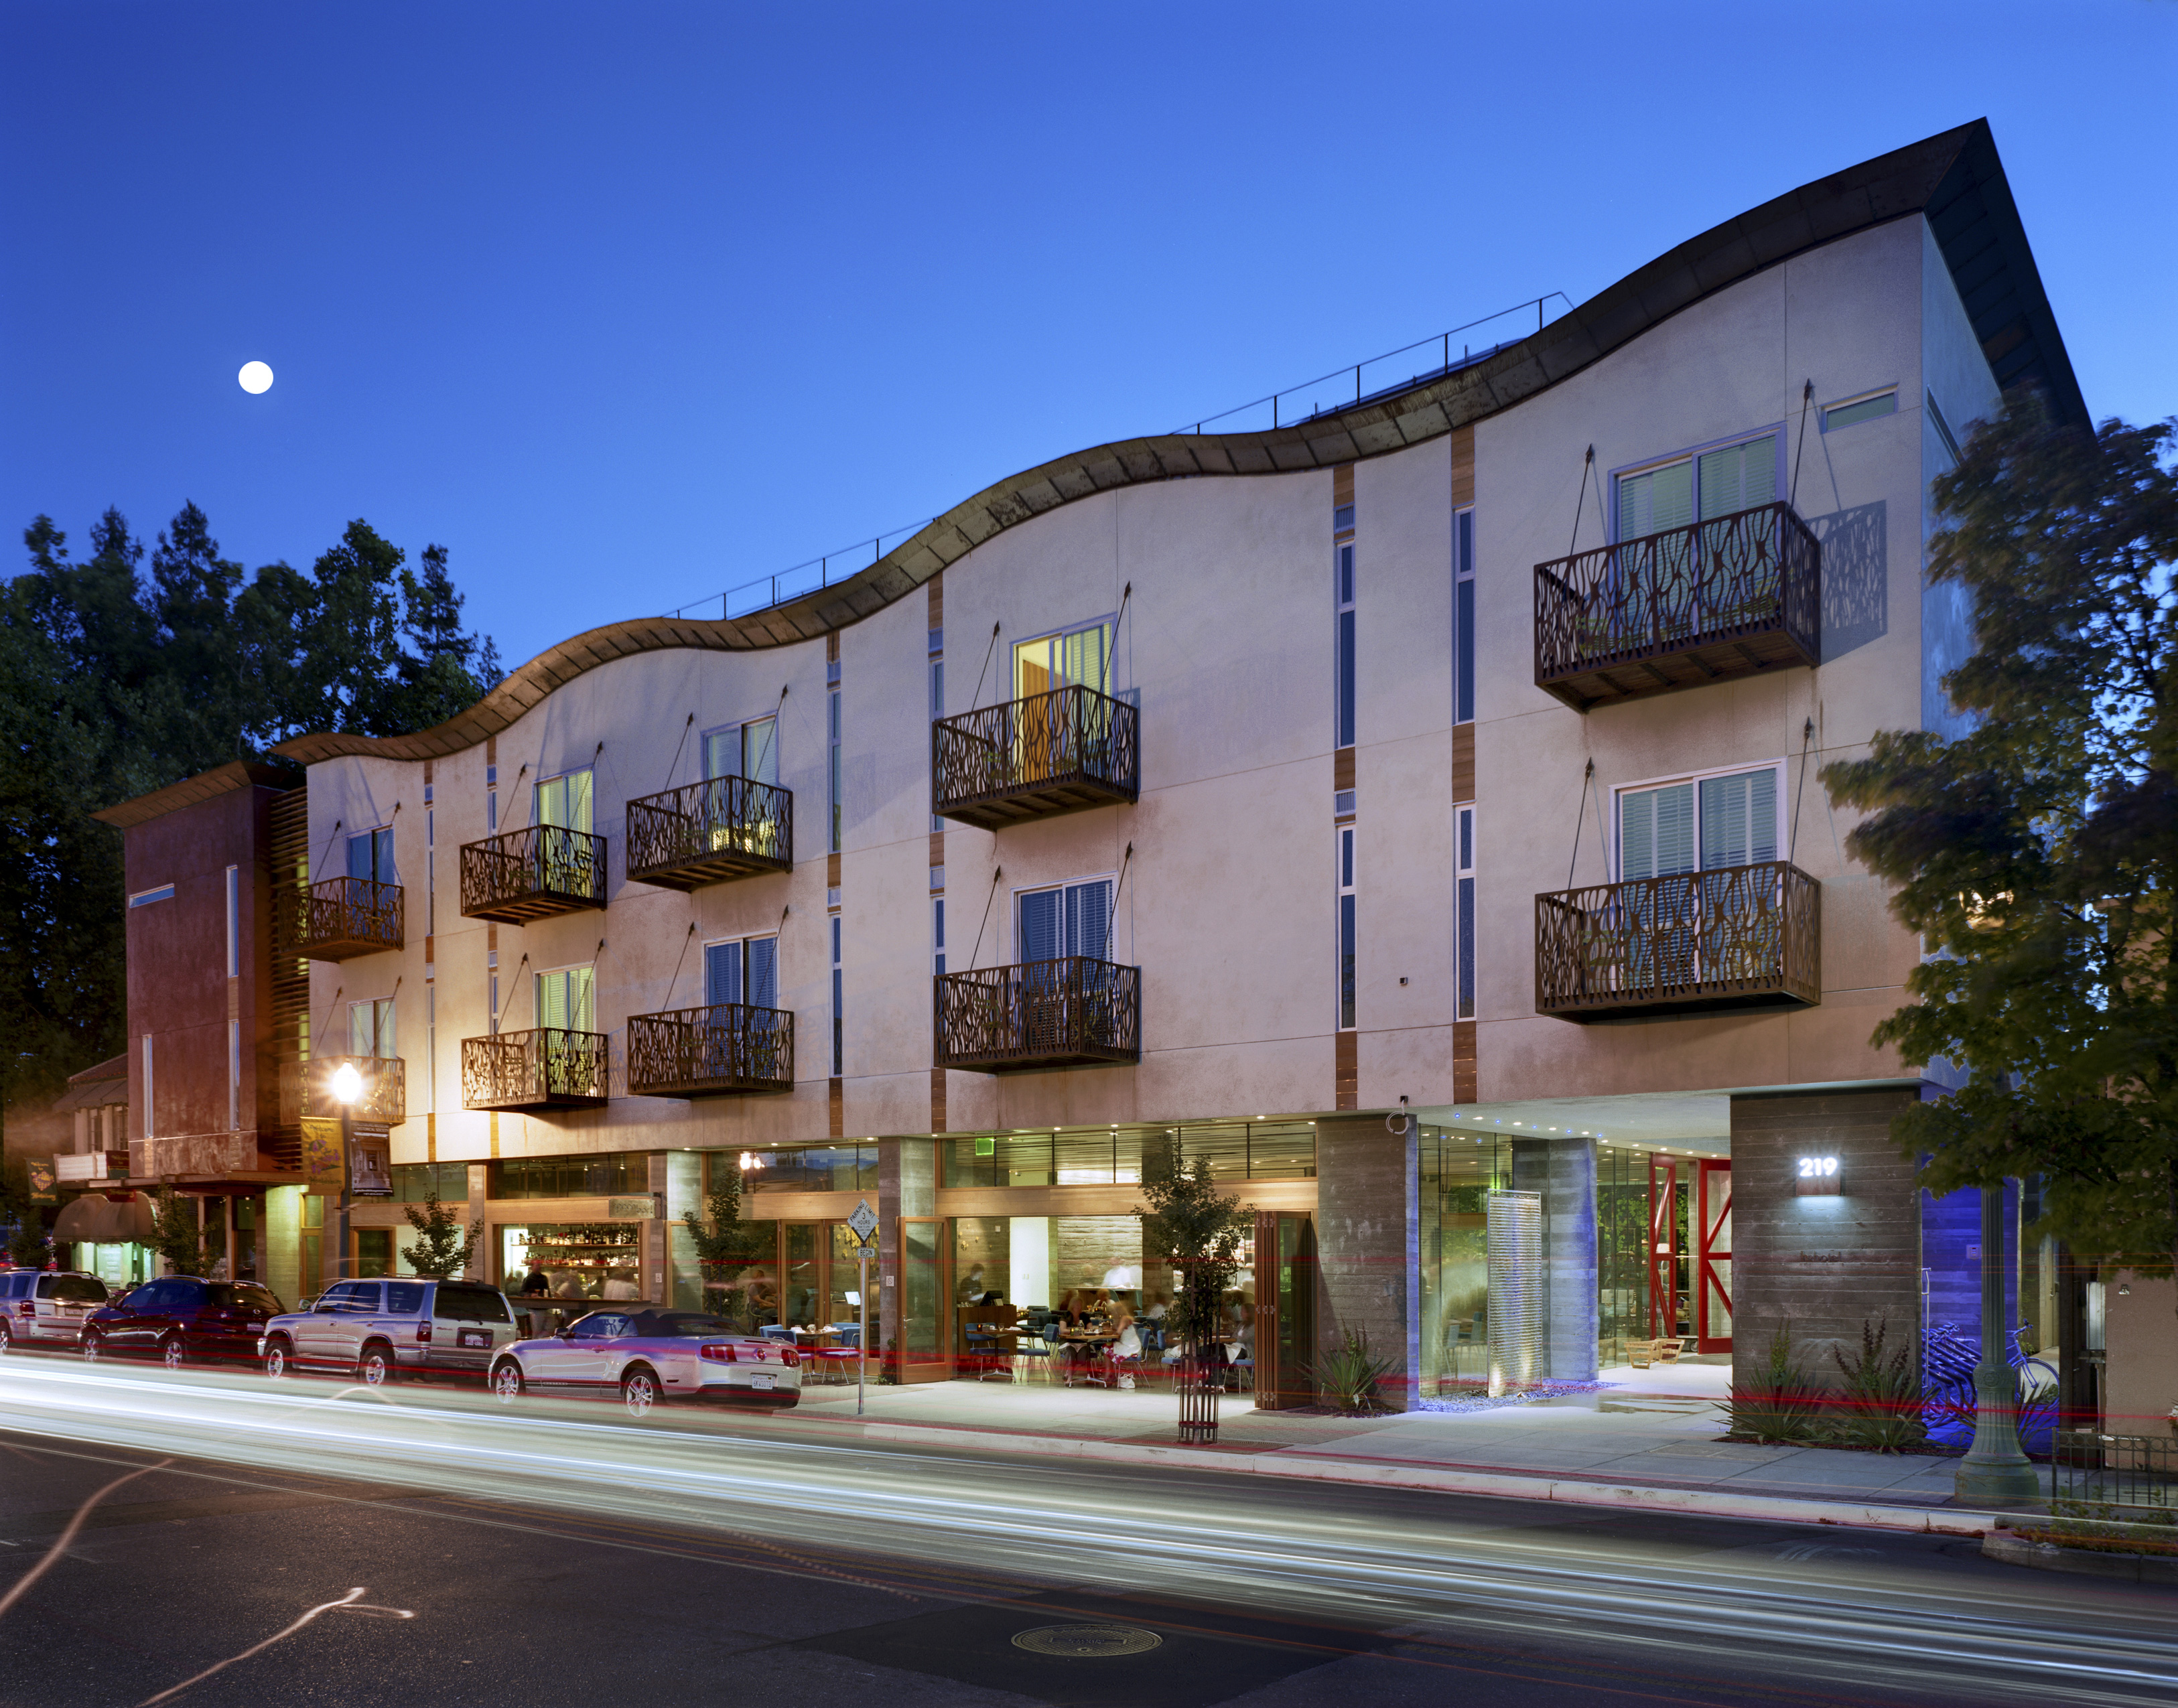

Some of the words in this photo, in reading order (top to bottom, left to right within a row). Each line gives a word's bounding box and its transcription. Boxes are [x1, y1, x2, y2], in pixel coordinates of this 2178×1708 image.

[1799, 1157, 1838, 1177] 219
[849, 1202, 865, 1222] PARKING
[864, 1204, 876, 1218] LIMIT
